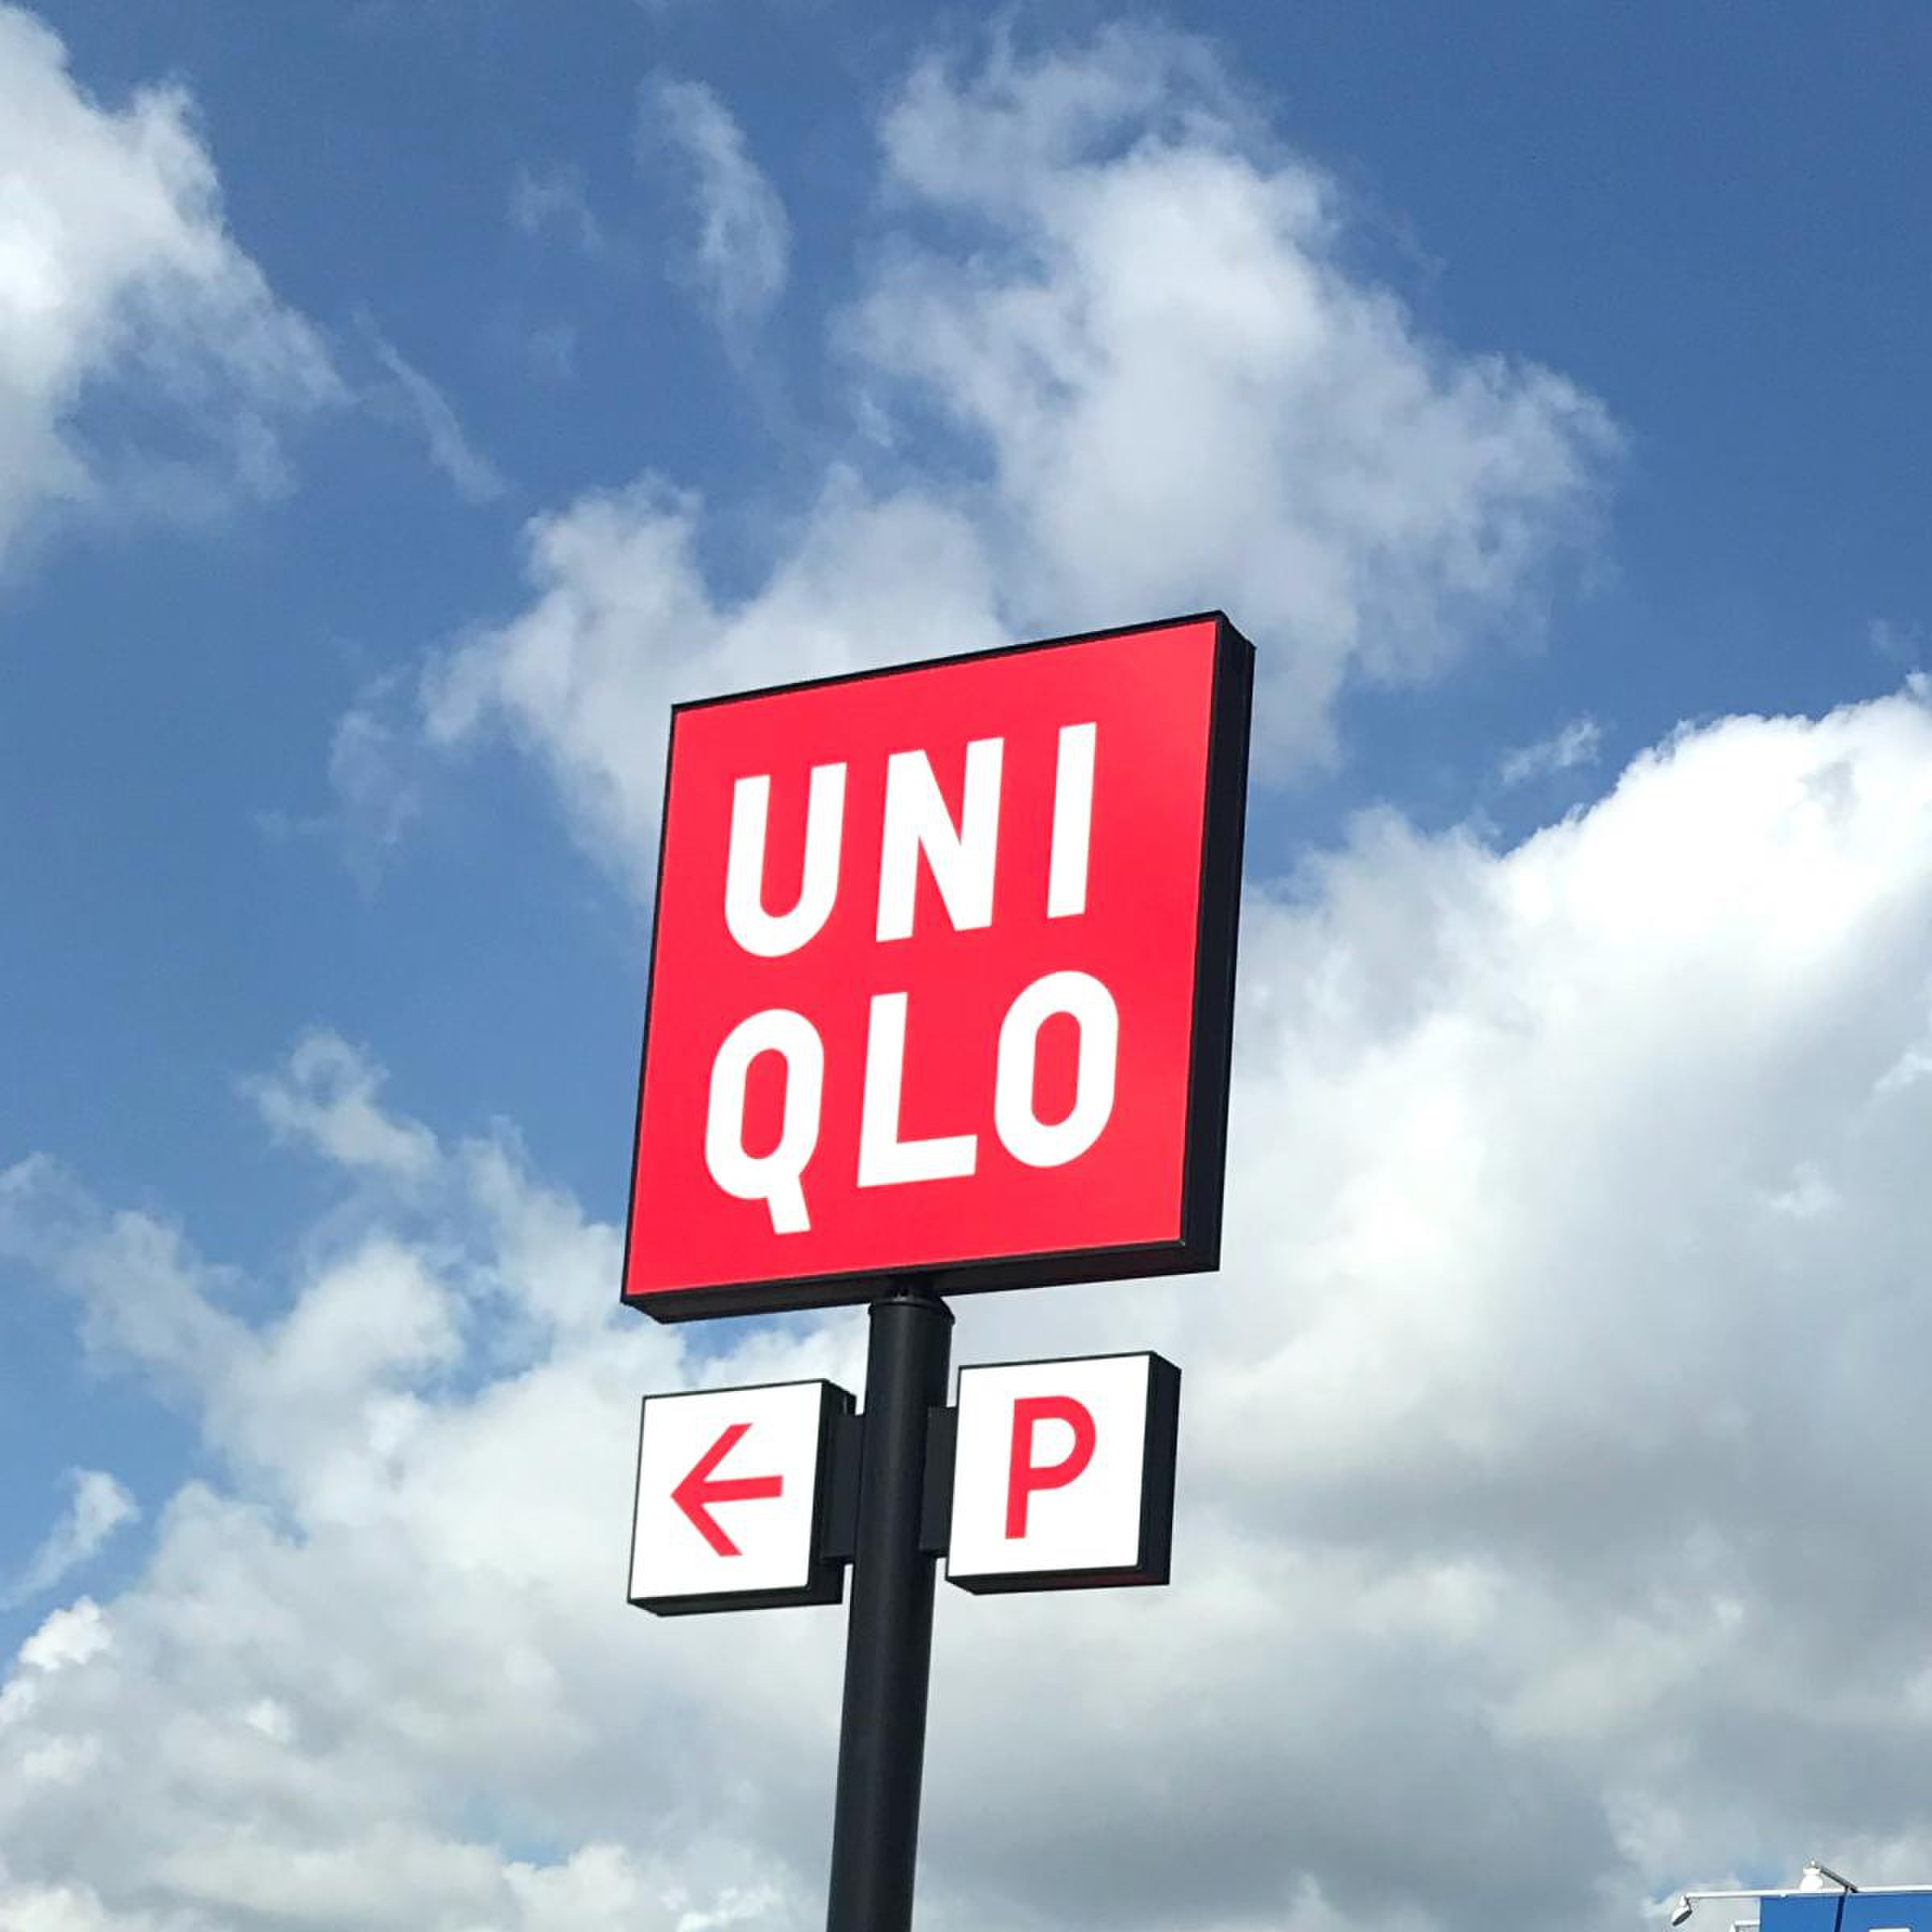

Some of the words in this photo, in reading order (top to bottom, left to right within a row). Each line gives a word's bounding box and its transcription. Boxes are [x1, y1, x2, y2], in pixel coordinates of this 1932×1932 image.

[724, 721, 1097, 958] UNI
[704, 970, 1120, 1235] QLO
[1005, 1395, 1097, 1539] P
